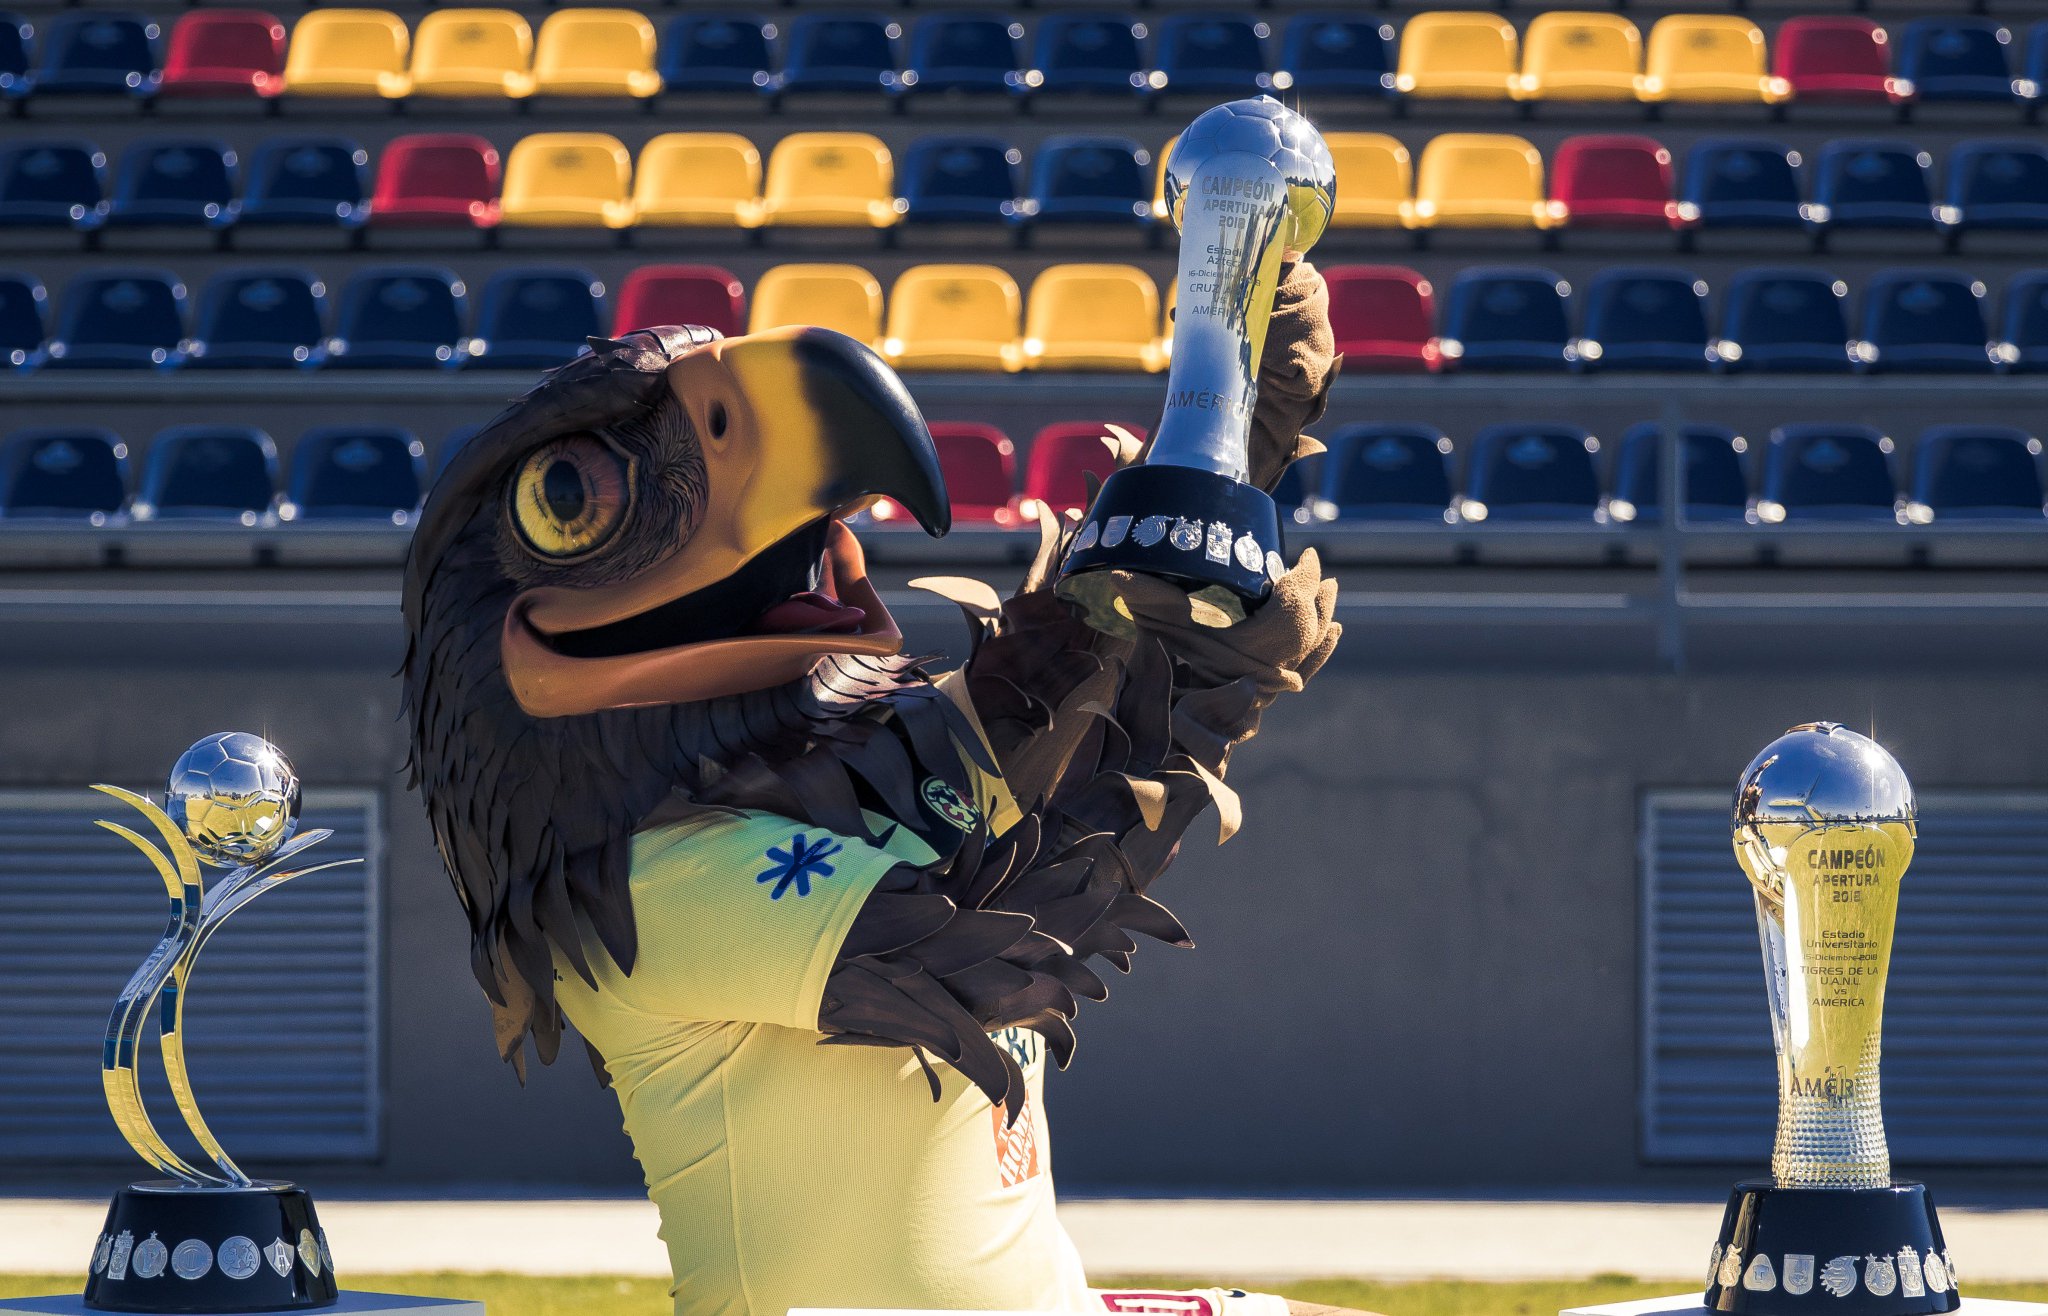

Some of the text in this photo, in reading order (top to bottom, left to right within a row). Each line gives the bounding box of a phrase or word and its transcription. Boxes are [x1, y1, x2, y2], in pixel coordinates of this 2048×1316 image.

[1201, 176, 1275, 202] CAMPEÓN
[1203, 199, 1265, 216] APERTURA
[1206, 244, 1243, 257] Estadi
[1807, 844, 1886, 870] CAMPEÓN
[1812, 874, 1880, 887] APERTURA
[1832, 890, 1862, 903] 2018
[1822, 930, 1865, 939] Estadio
[1806, 939, 1878, 949] Universitario
[1799, 965, 1879, 976] TIGRES DE LA
